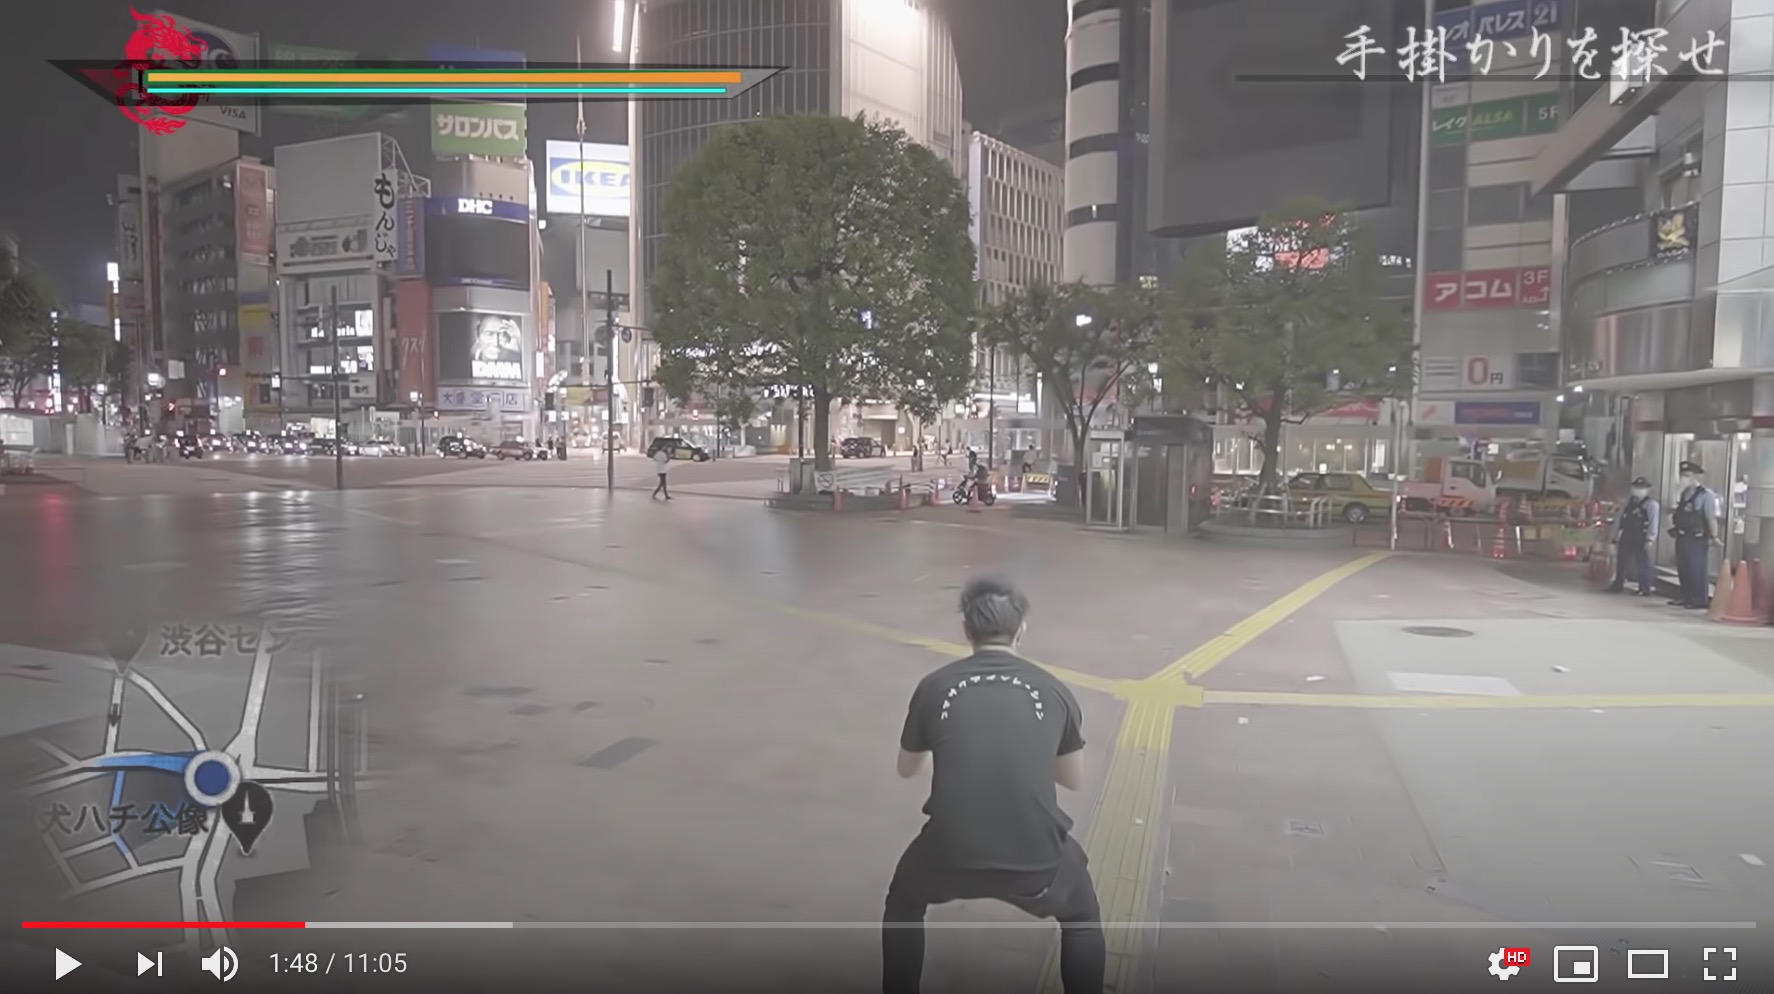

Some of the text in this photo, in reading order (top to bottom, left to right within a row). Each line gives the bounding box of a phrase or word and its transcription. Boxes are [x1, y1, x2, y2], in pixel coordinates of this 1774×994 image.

[219, 106, 247, 120] VISA
[437, 114, 519, 141] サロンパス
[560, 169, 630, 187] IKEA
[374, 173, 396, 258] もんじゃ
[458, 198, 493, 214] DHC
[1434, 279, 1513, 302] アコム
[1523, 270, 1549, 285] 3F
[471, 360, 522, 379] DMM
